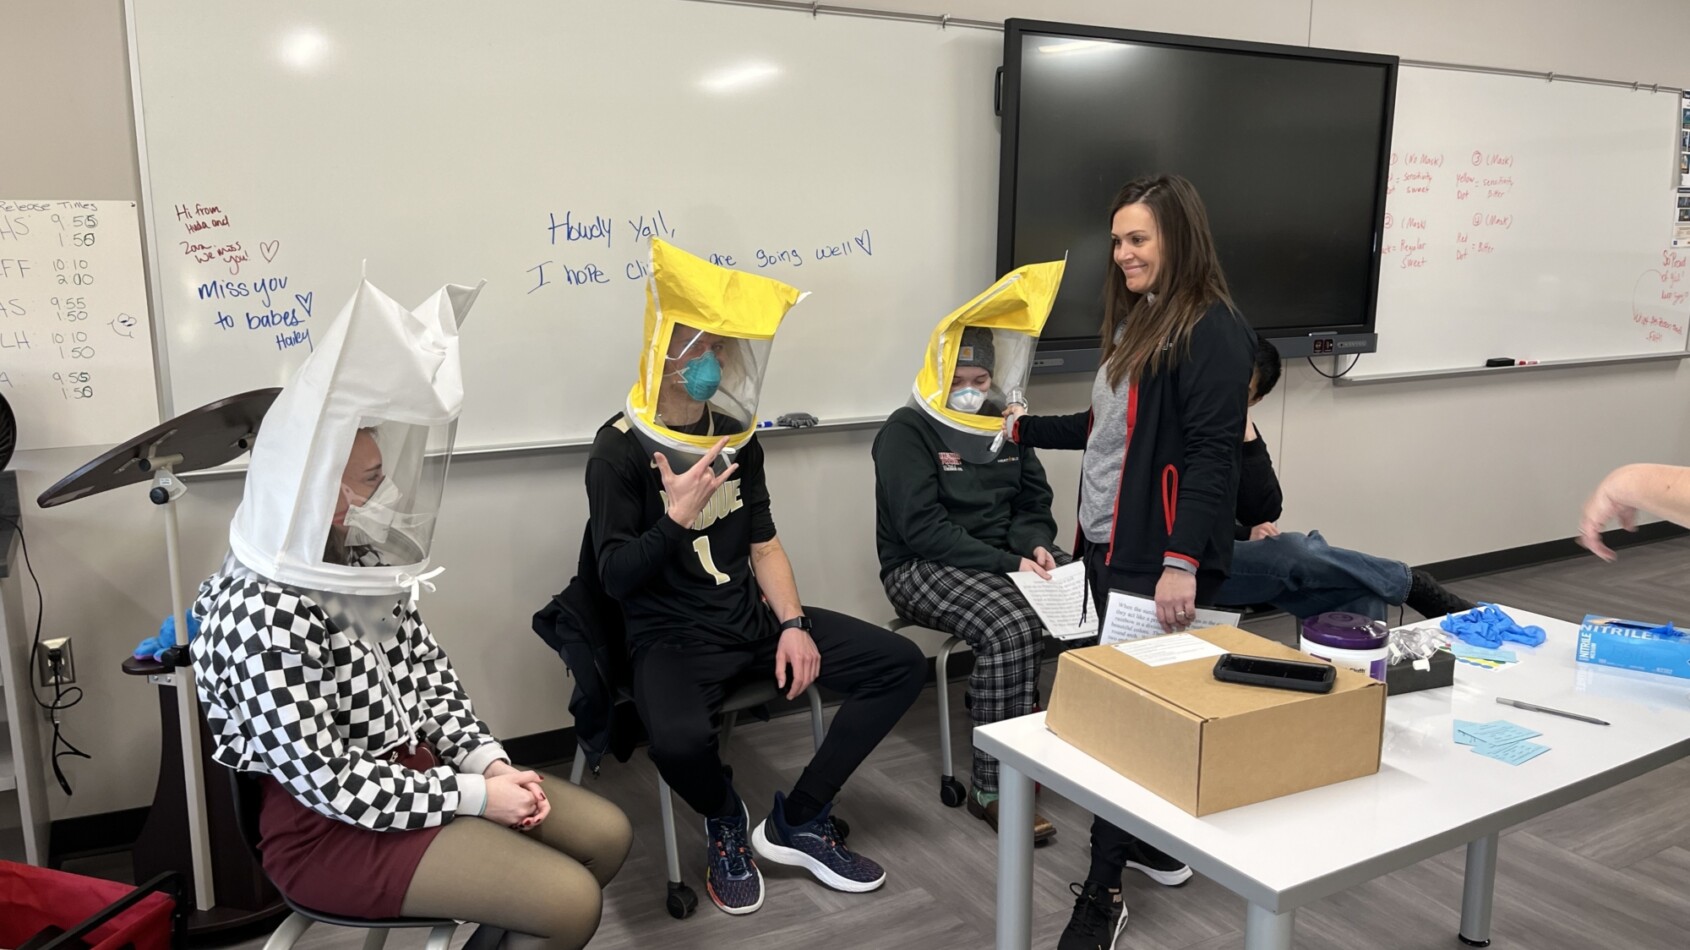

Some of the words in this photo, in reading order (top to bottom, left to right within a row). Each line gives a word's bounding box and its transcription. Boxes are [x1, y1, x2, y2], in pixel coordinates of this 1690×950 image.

[175, 204, 193, 222] Hi
[195, 203, 222, 216] from
[212, 215, 231, 227] and
[548, 211, 612, 248] Howdy
[526, 260, 553, 294] I
[709, 253, 737, 266] are
[756, 249, 803, 268] going
[815, 241, 853, 261] well
[254, 276, 288, 308] you
[214, 311, 235, 331] to
[245, 308, 305, 330] babes
[692, 535, 731, 585] 1
[1581, 624, 1653, 640] NITRILE
